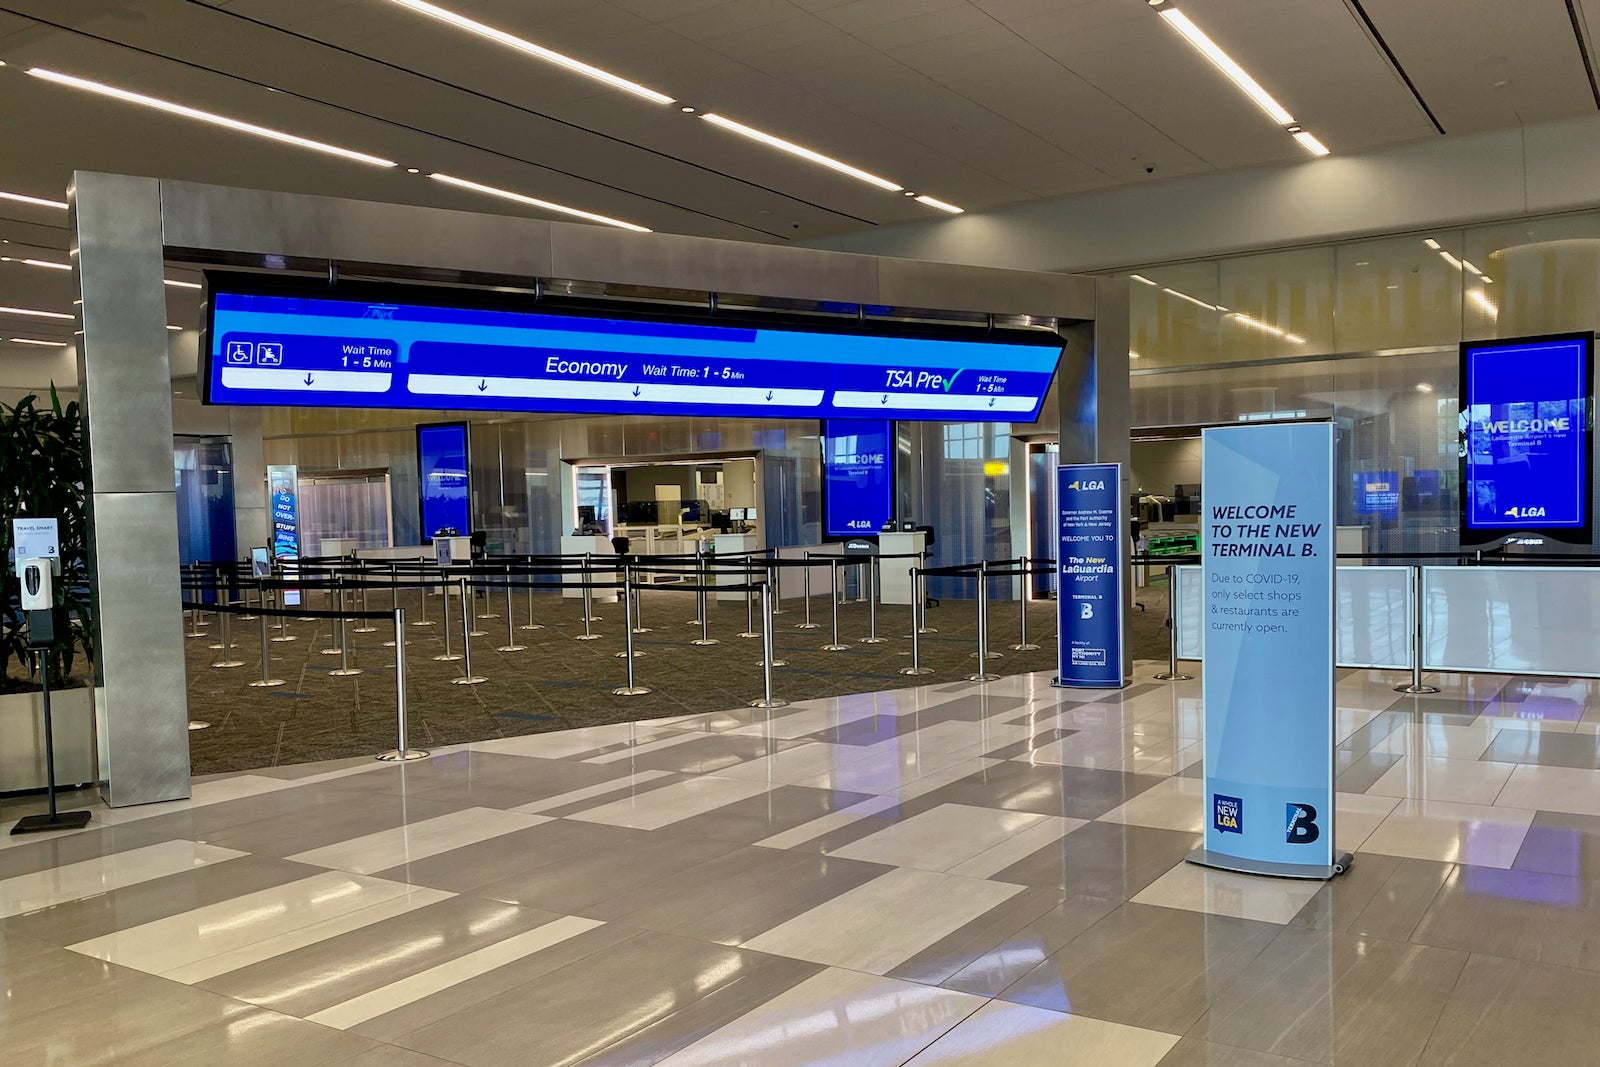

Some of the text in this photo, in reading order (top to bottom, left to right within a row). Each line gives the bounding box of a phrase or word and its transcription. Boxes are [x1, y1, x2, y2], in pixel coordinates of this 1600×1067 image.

[342, 345, 392, 356] Wait Time
[342, 356, 348, 366] 1
[362, 357, 371, 367] 5
[374, 359, 391, 368] Min
[546, 356, 628, 379] Economy
[642, 364, 668, 376] Wait
[671, 366, 700, 378] Time:
[703, 366, 710, 378] 1
[722, 367, 731, 379] 5
[885, 370, 942, 388] TSA Pre
[976, 384, 980, 392] 1
[987, 384, 993, 392] 5
[1482, 417, 1570, 434] WELCOME
[1082, 480, 1105, 490] LGA
[275, 512, 295, 520] OVER-
[1213, 505, 1297, 520] WELCOME
[1521, 507, 1545, 517] LGA
[276, 523, 295, 531] STUFF
[1212, 524, 1322, 538] TO THE NEW
[1212, 543, 1317, 557] TERMINAL B.
[1063, 564, 1114, 574] LaGuardia
[1212, 573, 1300, 585] Due to COVID-19,
[1212, 589, 1302, 602] only select shops
[1081, 602, 1094, 619] B
[1212, 604, 1299, 617] & restaurants are
[1212, 622, 1288, 634] currently open.
[1217, 805, 1238, 817] NEW
[1218, 815, 1238, 828] LGA
[1286, 807, 1303, 833] TERMINAL
[1286, 802, 1320, 844] B
